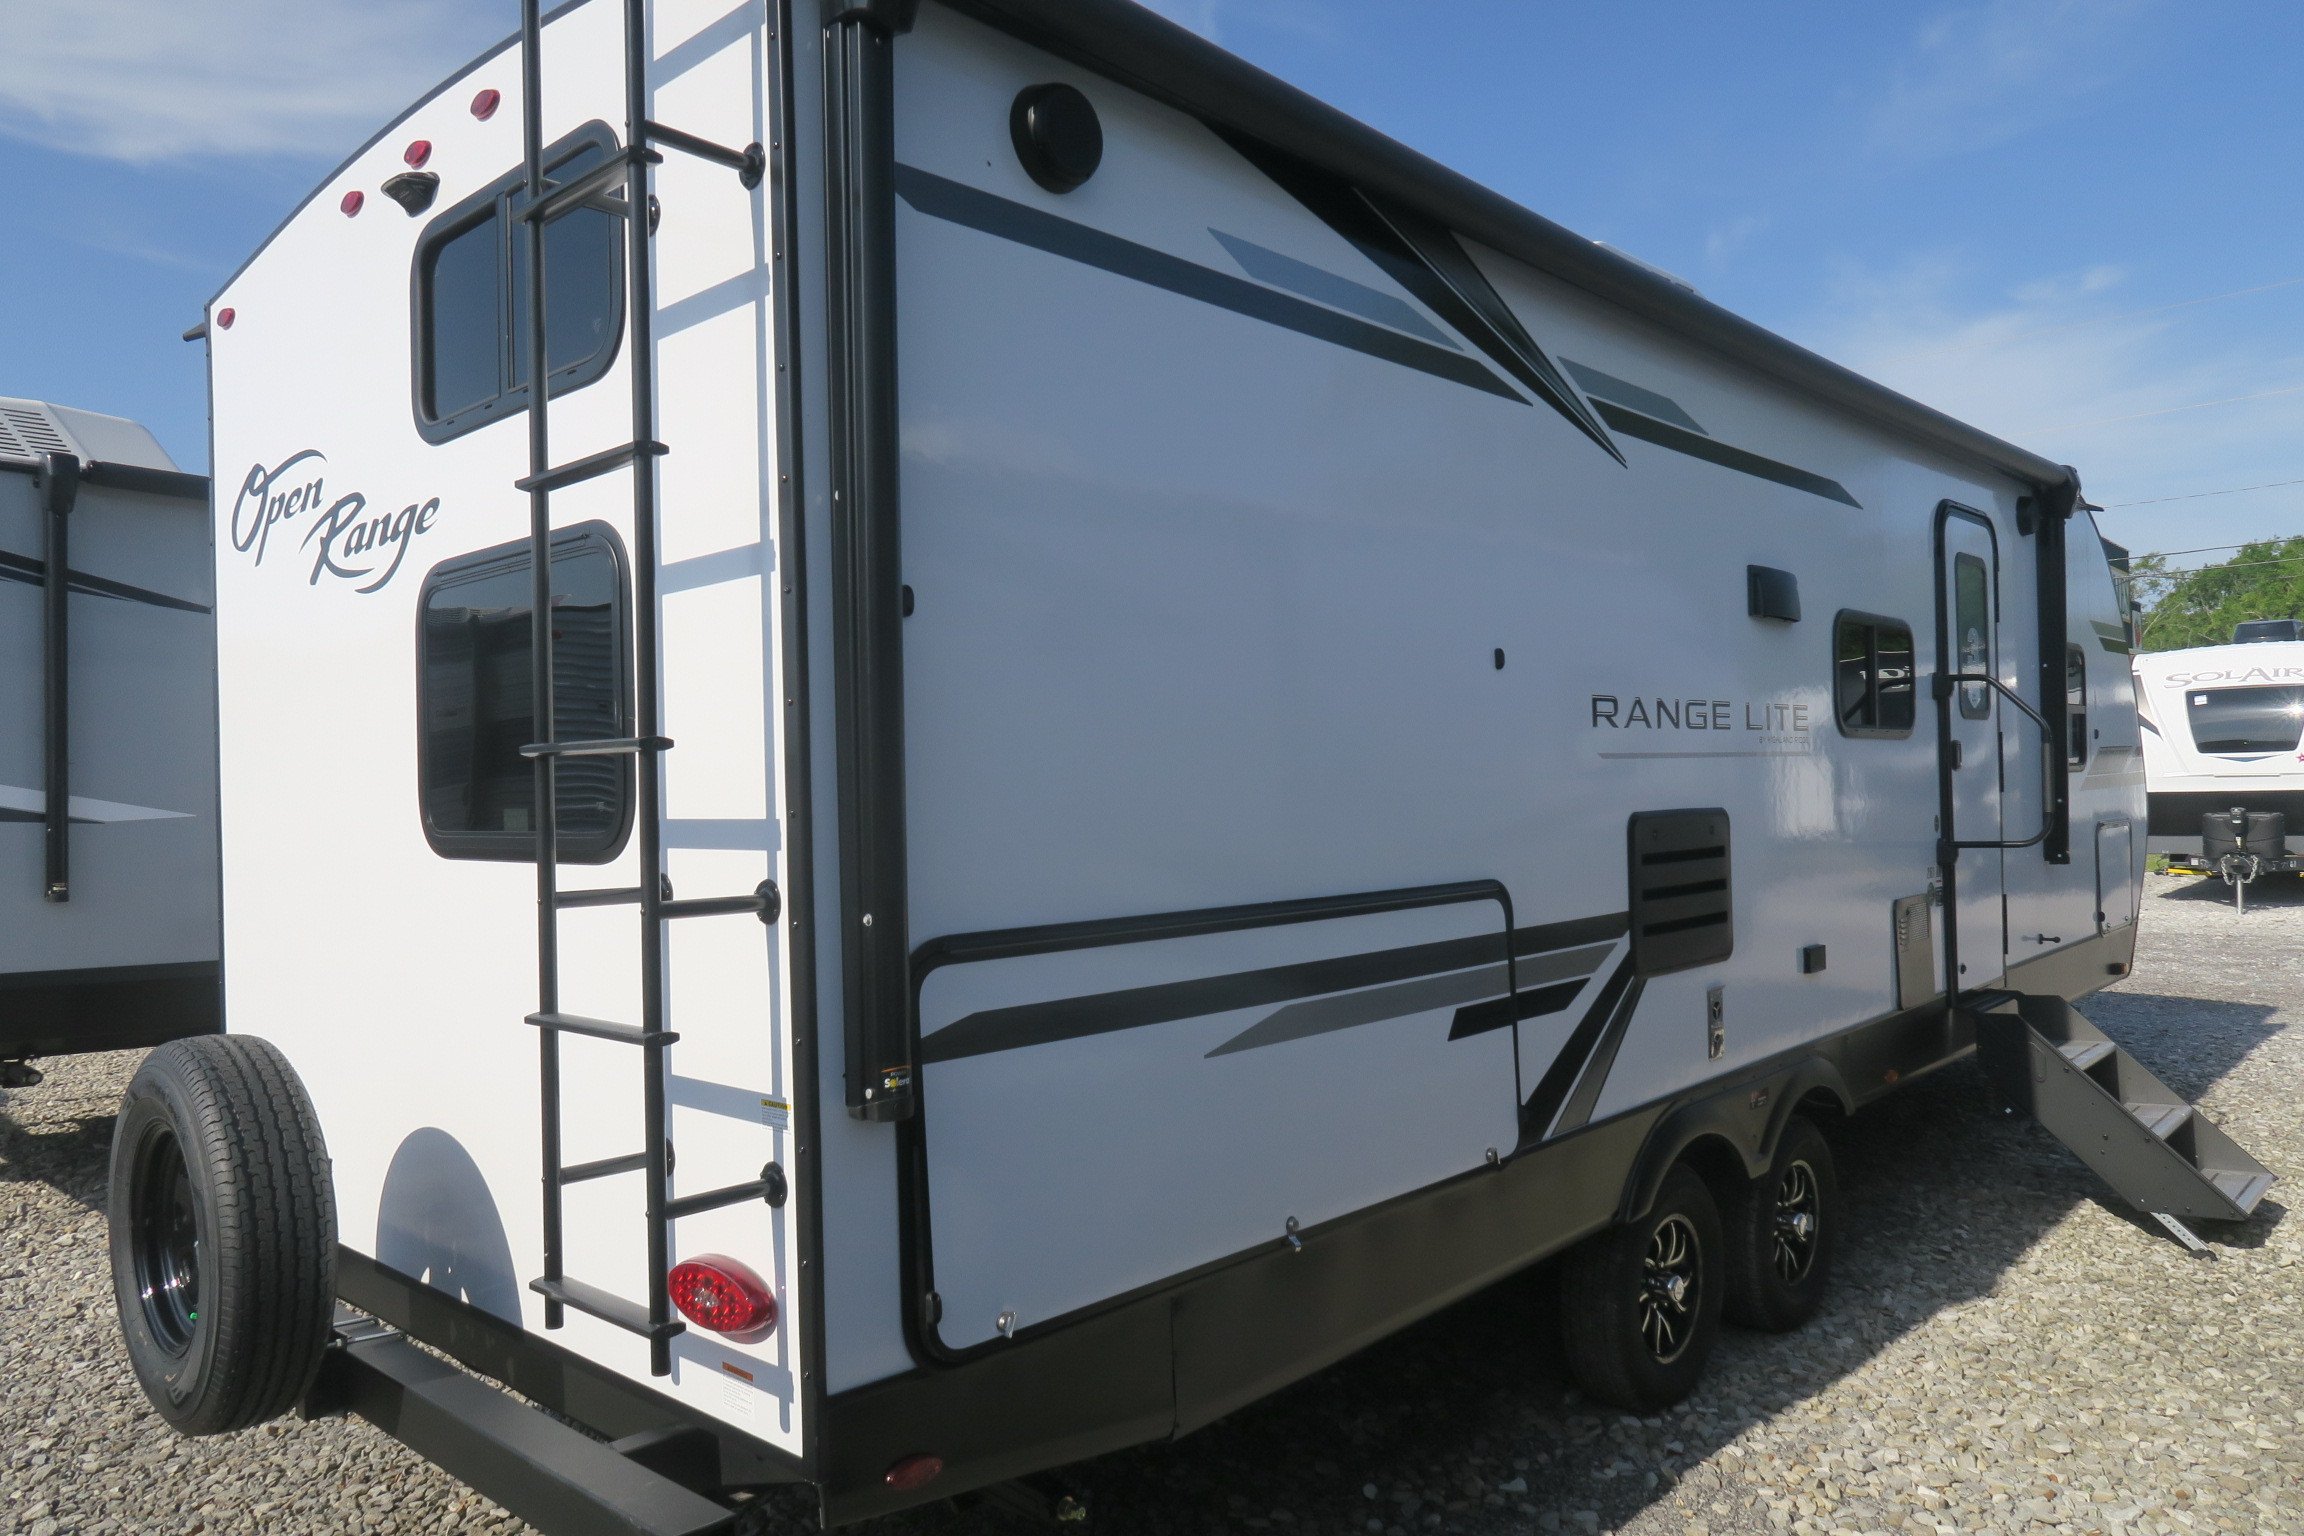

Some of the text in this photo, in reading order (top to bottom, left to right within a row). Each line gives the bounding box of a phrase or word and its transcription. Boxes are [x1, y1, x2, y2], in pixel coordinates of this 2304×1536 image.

[231, 448, 328, 567] Open
[299, 491, 441, 594] Range
[1591, 694, 1809, 732] RANGE LITE
